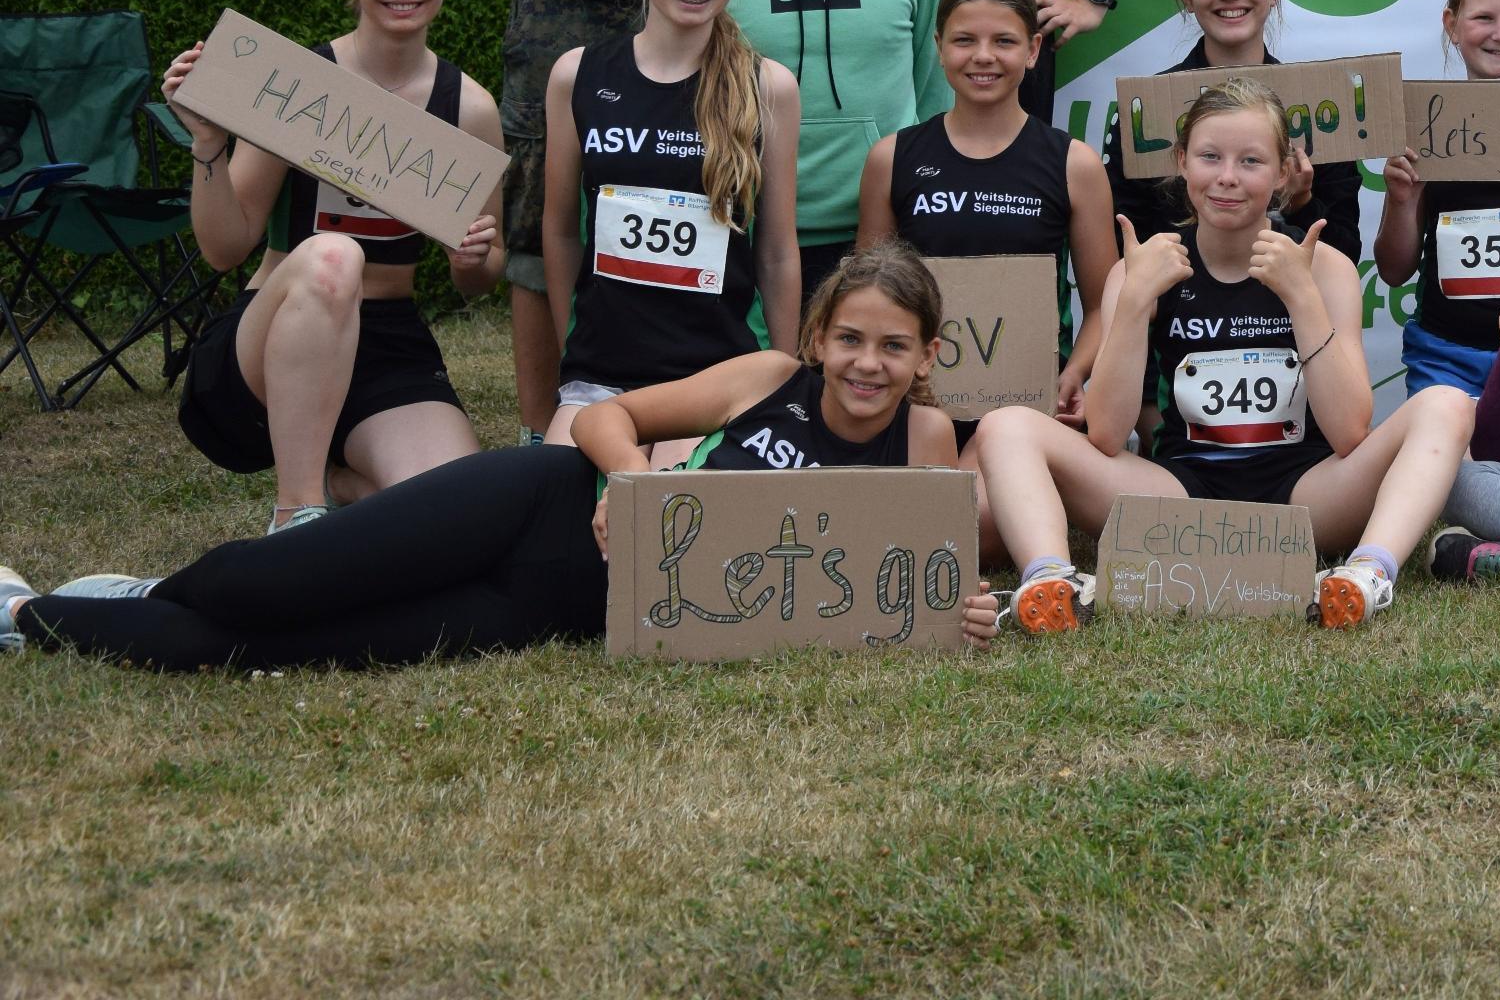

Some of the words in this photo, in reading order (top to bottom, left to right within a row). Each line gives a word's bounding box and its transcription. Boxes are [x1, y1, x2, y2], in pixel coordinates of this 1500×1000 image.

[252, 69, 482, 213] HANNAH
[584, 127, 650, 154] ASV
[656, 129, 702, 143] Veitsb
[1419, 94, 1487, 159] Let's
[655, 142, 707, 158] Siegels
[912, 191, 968, 216] ASV
[974, 191, 1042, 206] Veitsbronn
[973, 202, 1042, 217] Siegelsdorf
[619, 213, 698, 257] 359
[936, 316, 1005, 370] SV
[1169, 317, 1224, 340] ASV
[1229, 327, 1293, 338] Siegelsdor
[1201, 376, 1278, 416] 349
[1115, 500, 1311, 557] Leichtathletik
[650, 493, 854, 628] Let's
[866, 547, 961, 647] go
